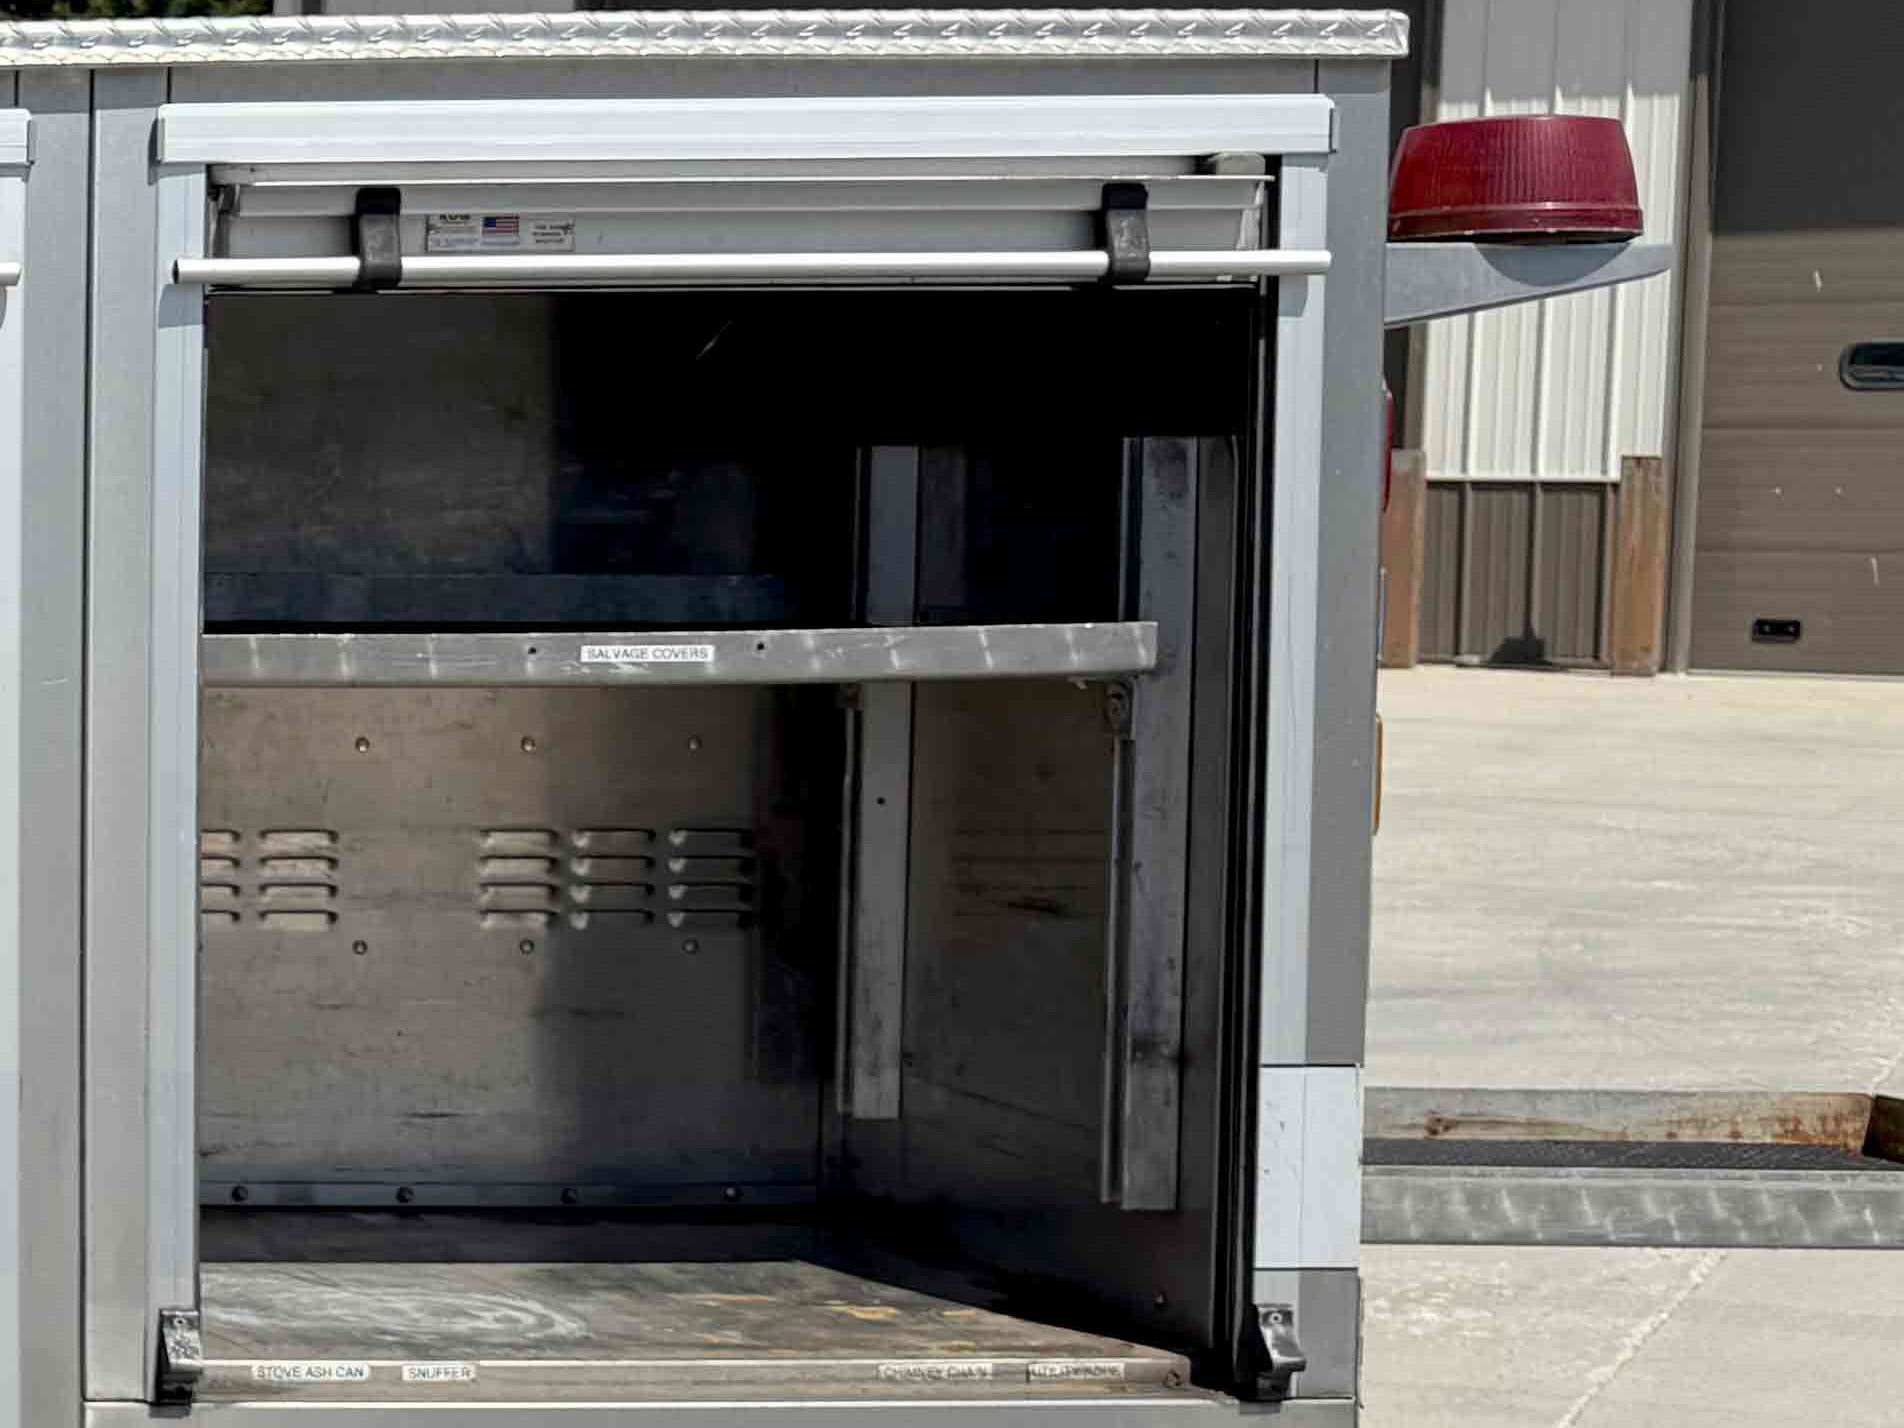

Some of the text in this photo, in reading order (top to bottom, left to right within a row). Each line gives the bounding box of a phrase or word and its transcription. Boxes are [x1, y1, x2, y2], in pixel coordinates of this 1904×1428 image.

[652, 647, 709, 660] COVERS
[256, 1365, 364, 1379] STOVE ASH CAN
